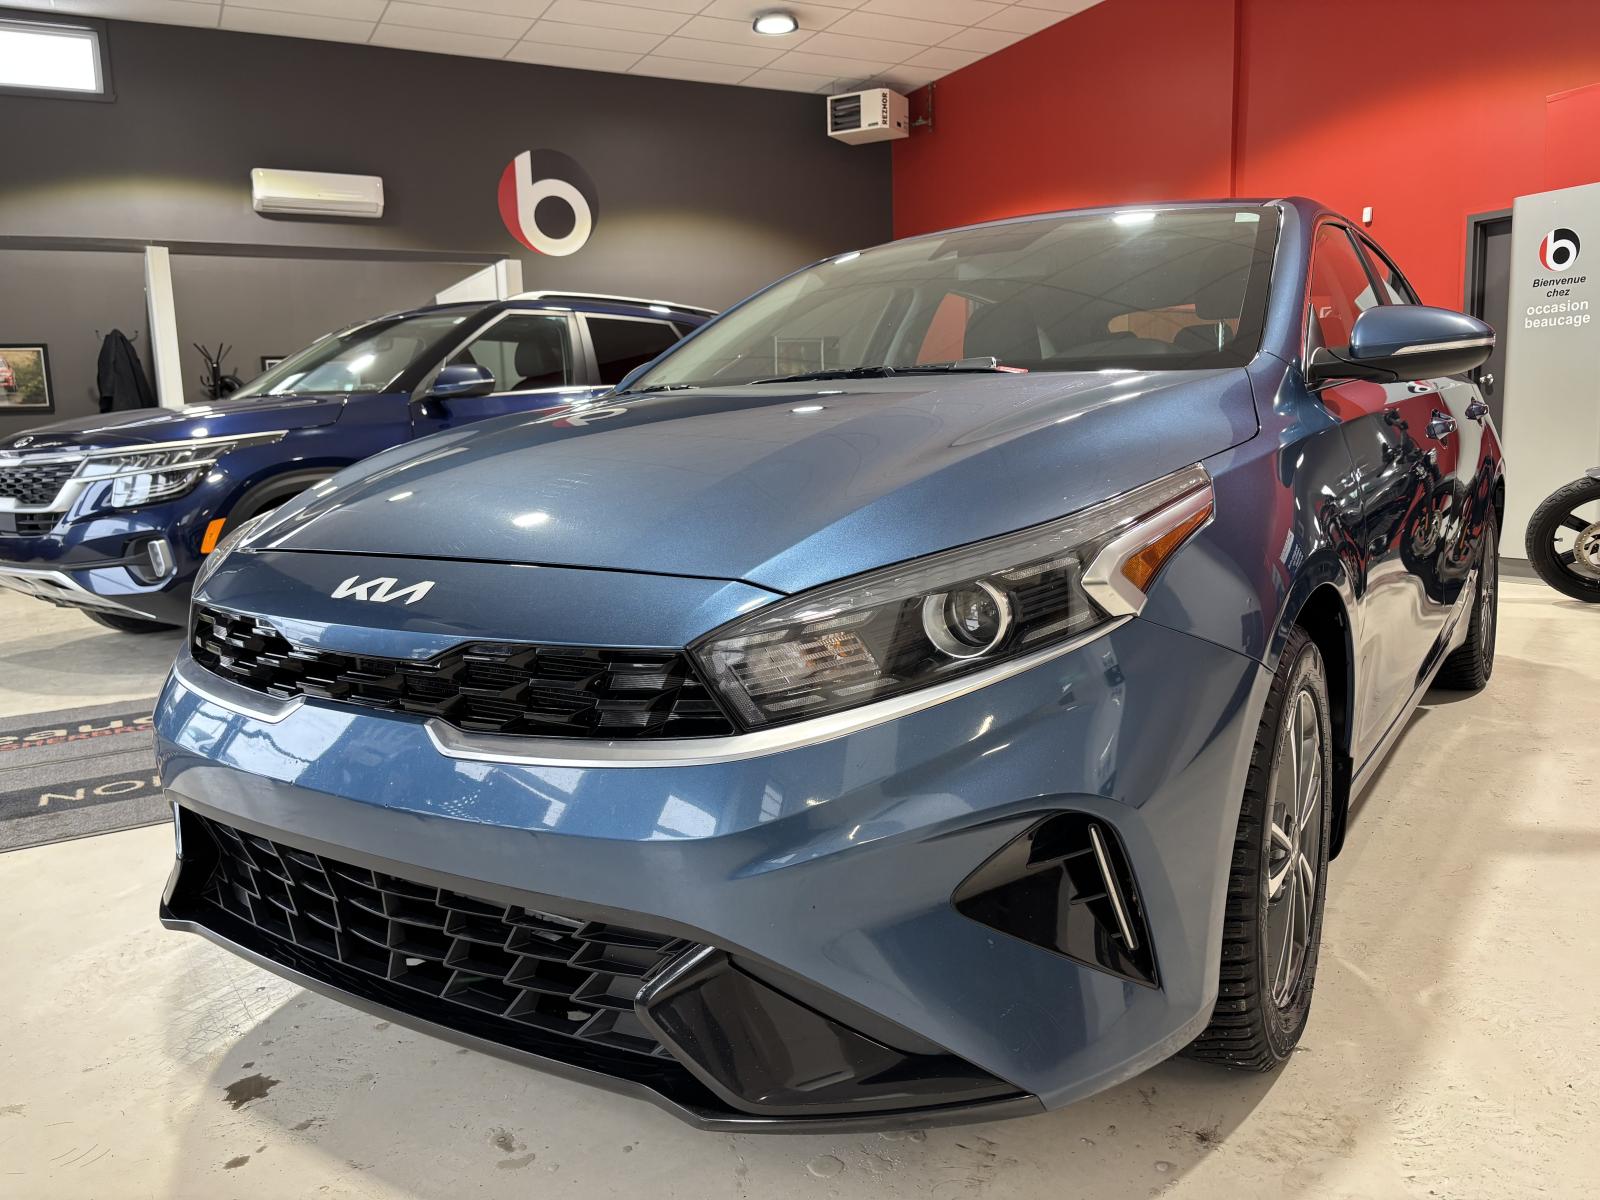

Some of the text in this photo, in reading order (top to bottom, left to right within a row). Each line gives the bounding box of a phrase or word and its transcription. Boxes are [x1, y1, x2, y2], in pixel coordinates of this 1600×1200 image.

[514, 150, 592, 257] b
[1532, 276, 1586, 288] Bienvenue
[1546, 288, 1570, 298] chez
[1527, 300, 1589, 316] occasion
[1525, 313, 1591, 329] beaucage
[331, 575, 436, 605] KIA
